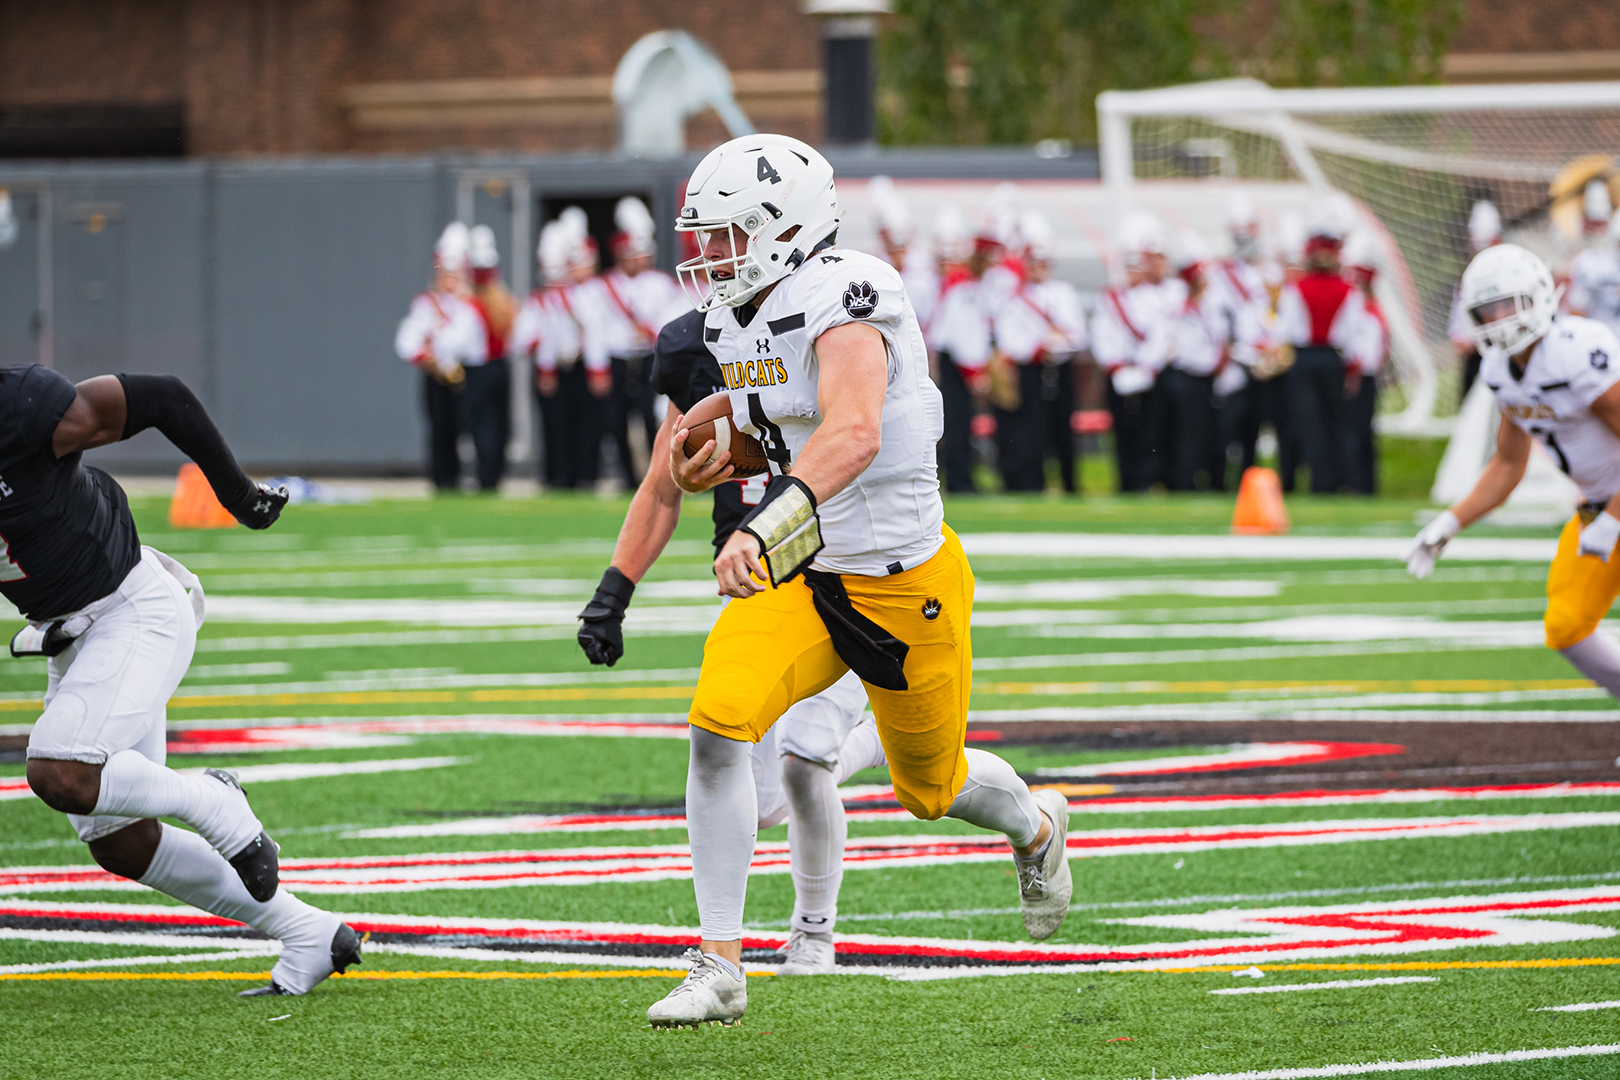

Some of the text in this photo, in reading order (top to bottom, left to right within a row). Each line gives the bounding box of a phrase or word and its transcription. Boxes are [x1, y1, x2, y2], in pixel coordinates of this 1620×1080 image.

[757, 156, 782, 185] 4
[820, 256, 844, 264] 4
[849, 297, 872, 307] WSC
[747, 393, 792, 477] 4
